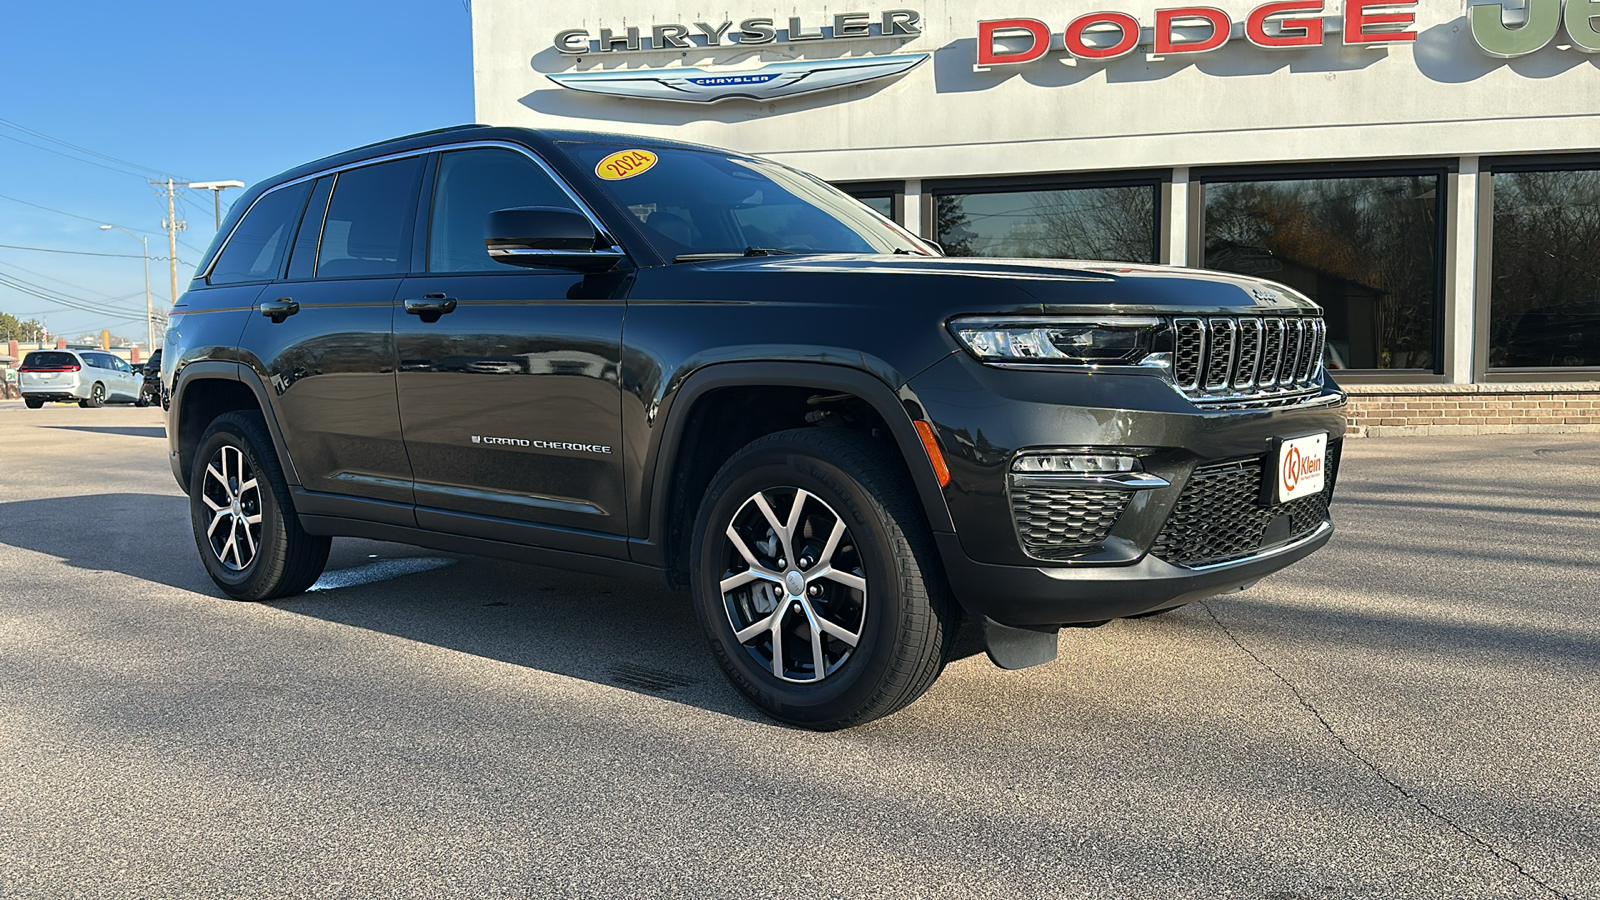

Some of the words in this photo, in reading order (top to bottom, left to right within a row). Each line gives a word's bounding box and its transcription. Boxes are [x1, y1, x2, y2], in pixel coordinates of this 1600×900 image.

[554, 9, 921, 54] CHRYSLER
[977, 0, 1418, 67] DODGE
[696, 76, 769, 85] CHRYSLER
[606, 151, 651, 177] 2024
[483, 436, 531, 447] GRAND
[533, 440, 612, 454] CHEROKEE
[1301, 454, 1322, 476] Klein
